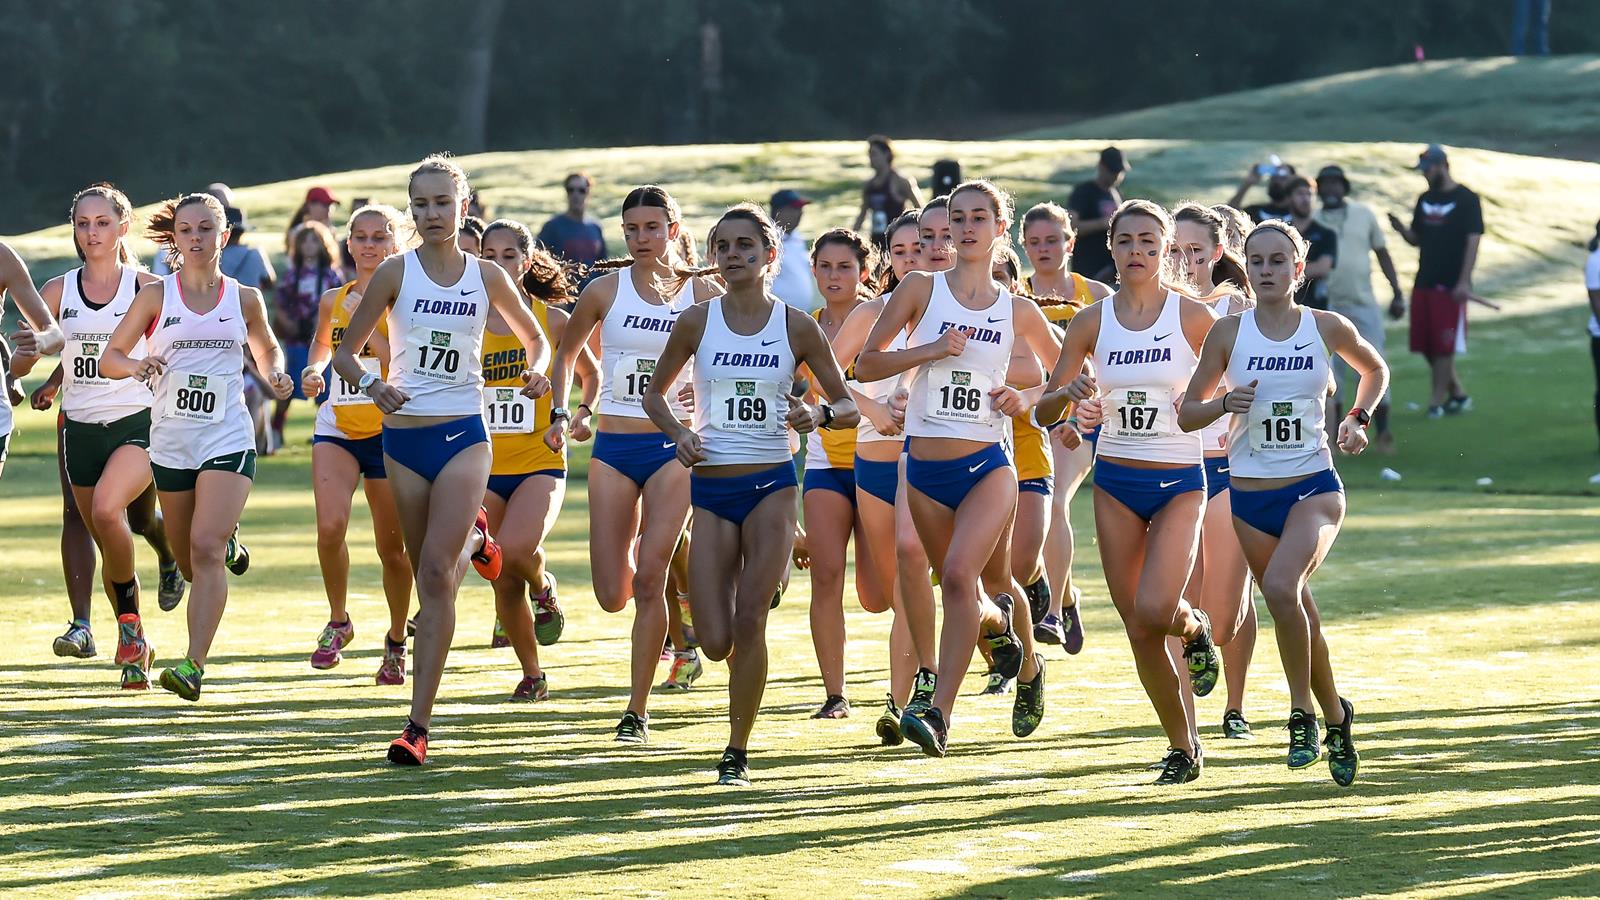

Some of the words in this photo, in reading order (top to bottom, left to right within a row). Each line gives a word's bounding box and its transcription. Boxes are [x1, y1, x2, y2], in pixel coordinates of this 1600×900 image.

[412, 299, 477, 317] FLORIDA
[622, 314, 676, 333] FLORID
[937, 321, 1002, 345] FORIDA
[172, 339, 235, 349] STETSON
[418, 345, 460, 374] 170
[483, 347, 527, 367] EMBR
[711, 352, 780, 369] FLORIDA
[1106, 347, 1172, 366] FLORIDA
[1246, 355, 1314, 371] FLORIDA
[73, 356, 101, 379] 80
[412, 368, 426, 376] Gator
[427, 371, 457, 381] Invitational
[625, 373, 652, 396] 16
[176, 388, 216, 414] 800
[940, 385, 982, 412] 166
[186, 412, 214, 421] Invitational
[487, 402, 524, 424] 110
[724, 397, 767, 422] 169
[936, 409, 950, 417] Gator
[950, 411, 980, 420] Invitational
[1117, 406, 1159, 430] 167
[737, 422, 767, 430] Invitational
[1130, 430, 1159, 438] Invitational
[1261, 417, 1302, 442] 161
[1275, 442, 1305, 450] Invitational
